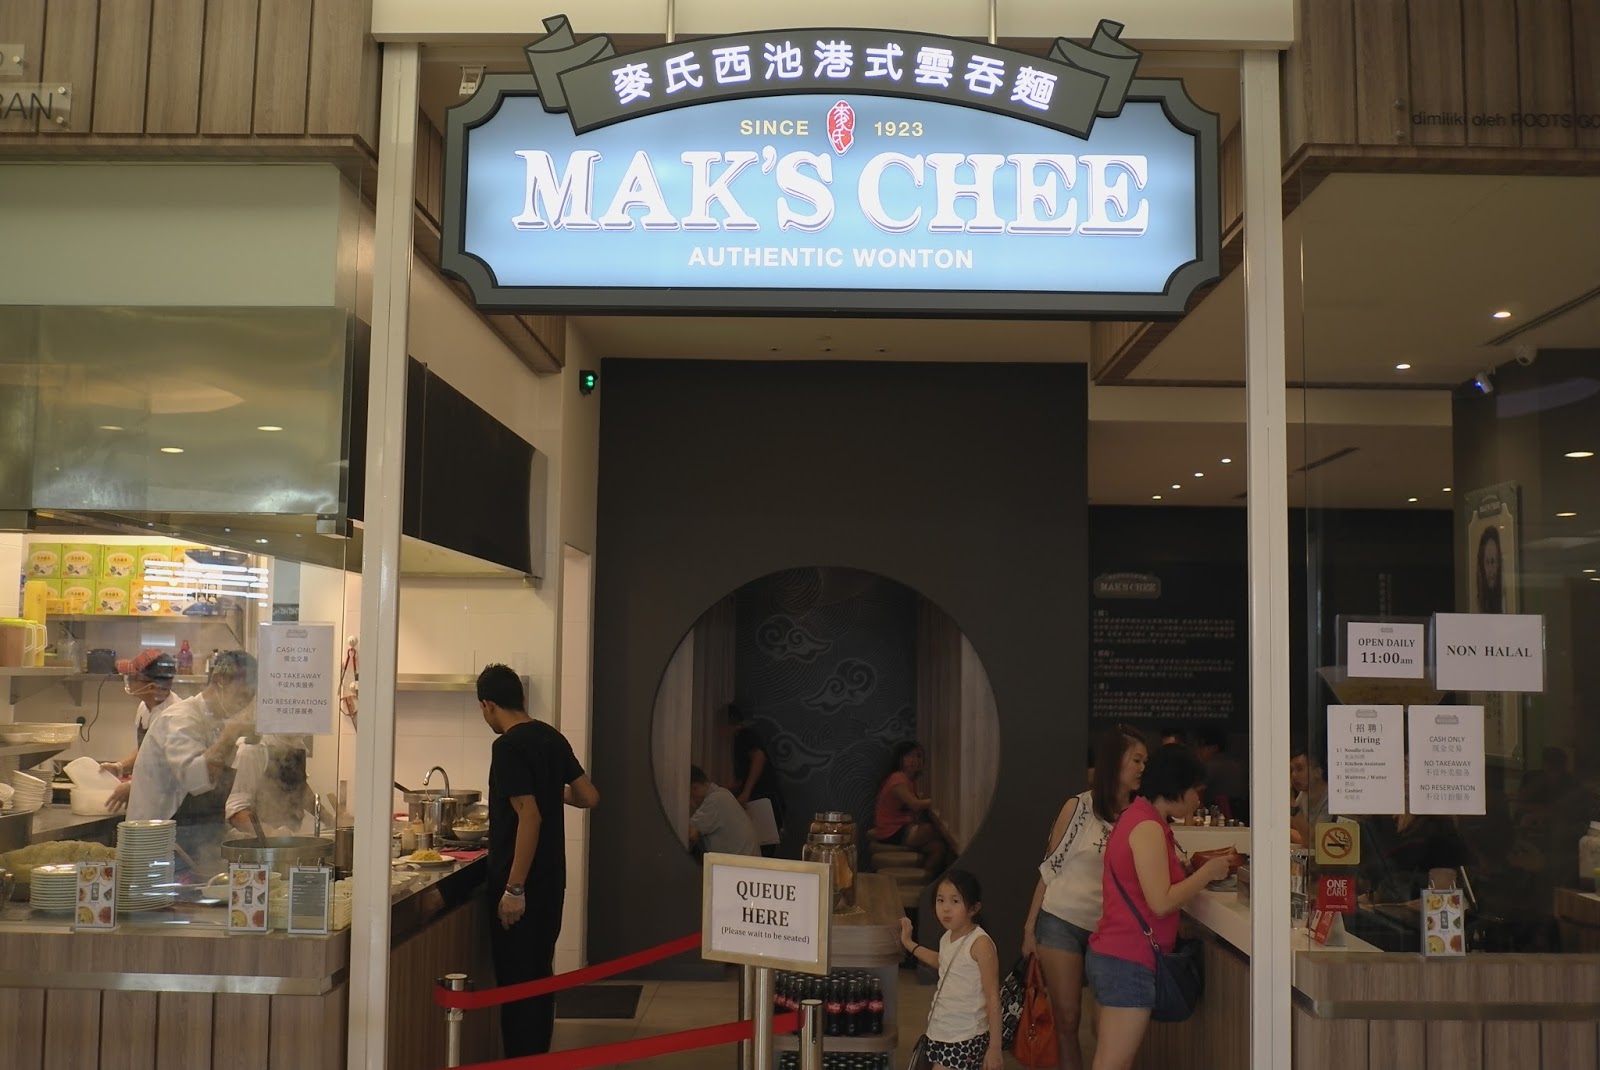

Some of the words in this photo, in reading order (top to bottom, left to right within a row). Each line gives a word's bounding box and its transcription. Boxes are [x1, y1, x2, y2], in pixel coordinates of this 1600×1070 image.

[1472, 112, 1506, 127] oleh
[1511, 113, 1572, 128] ROOTS
[740, 120, 809, 136] SINCE
[874, 121, 924, 137] 1923
[511, 145, 835, 234] MAK'S
[858, 151, 1149, 237] CHEE
[687, 247, 844, 267] AUTHENTIC
[852, 248, 973, 269] WONTON
[1358, 637, 1385, 647] OPEN
[1386, 638, 1416, 648] DAILY
[1447, 645, 1477, 657] NON
[1484, 646, 1533, 658] HALAL
[1353, 736, 1381, 745] Hiring
[736, 880, 797, 902] QUEUE
[1326, 879, 1347, 888] ONE
[1326, 888, 1347, 896] CARD
[742, 906, 790, 927] HERE
[721, 926, 746, 936] (Please
[747, 929, 763, 938] wait
[764, 931, 772, 939] to
[773, 932, 783, 940] be
[783, 934, 810, 944] seated)
